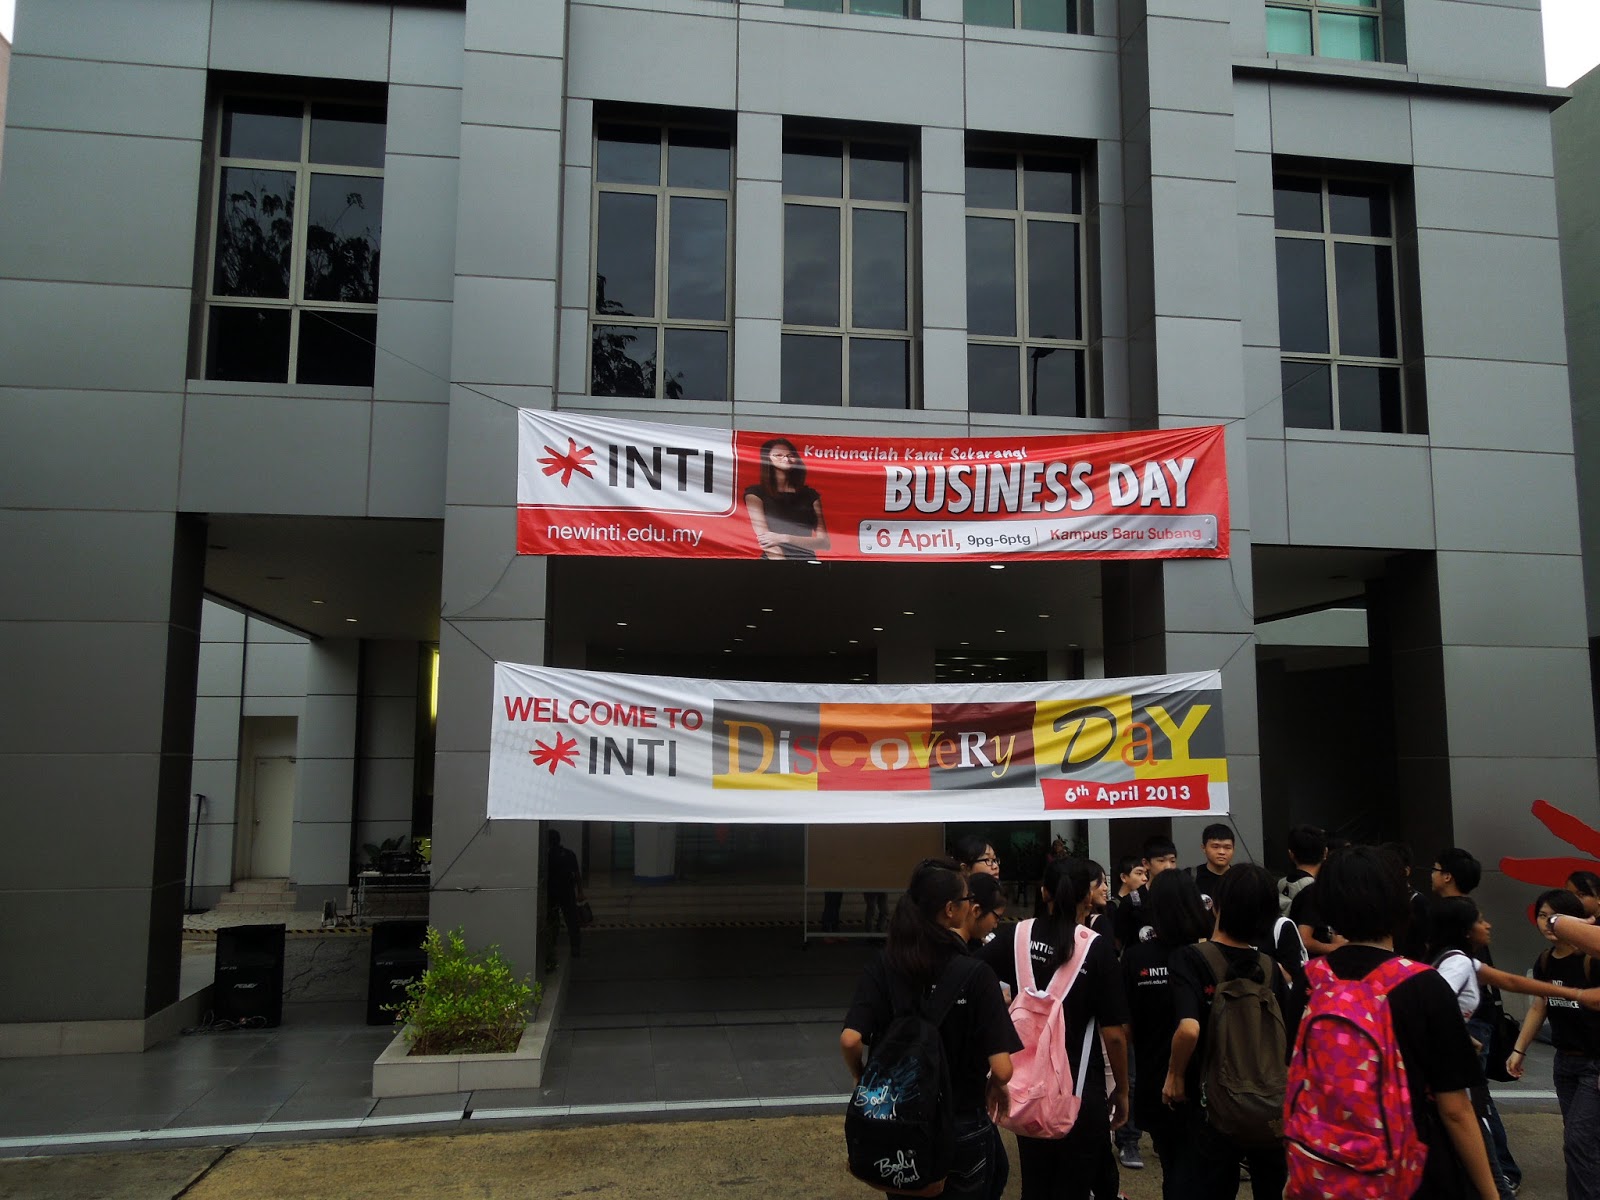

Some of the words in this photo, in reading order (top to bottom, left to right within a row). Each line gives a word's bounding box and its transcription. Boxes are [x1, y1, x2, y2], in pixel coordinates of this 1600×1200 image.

[804, 445, 898, 461] Kunjungilah
[904, 448, 944, 460] Kami
[608, 444, 714, 494] INTI
[883, 460, 1094, 514] BUSINESS
[1108, 457, 1196, 508] DAY
[547, 523, 703, 546] newinti.edu.my
[876, 528, 891, 547] 6
[898, 528, 961, 550] April,
[967, 534, 1031, 548] 9pg-6ptg
[1050, 528, 1108, 542] Kampus
[1112, 527, 1144, 540] Baru
[1147, 527, 1202, 540] Subang
[504, 696, 658, 728] WELCOME
[663, 707, 703, 731] TO
[588, 736, 677, 777] INTI
[1065, 785, 1089, 802] 6th
[1096, 785, 1139, 805] April
[1146, 785, 1191, 800] 2013
[1030, 940, 1048, 953] INTI
[1149, 967, 1168, 977] INTI
[854, 1085, 899, 1116] Body
[874, 1149, 920, 1181] Body
